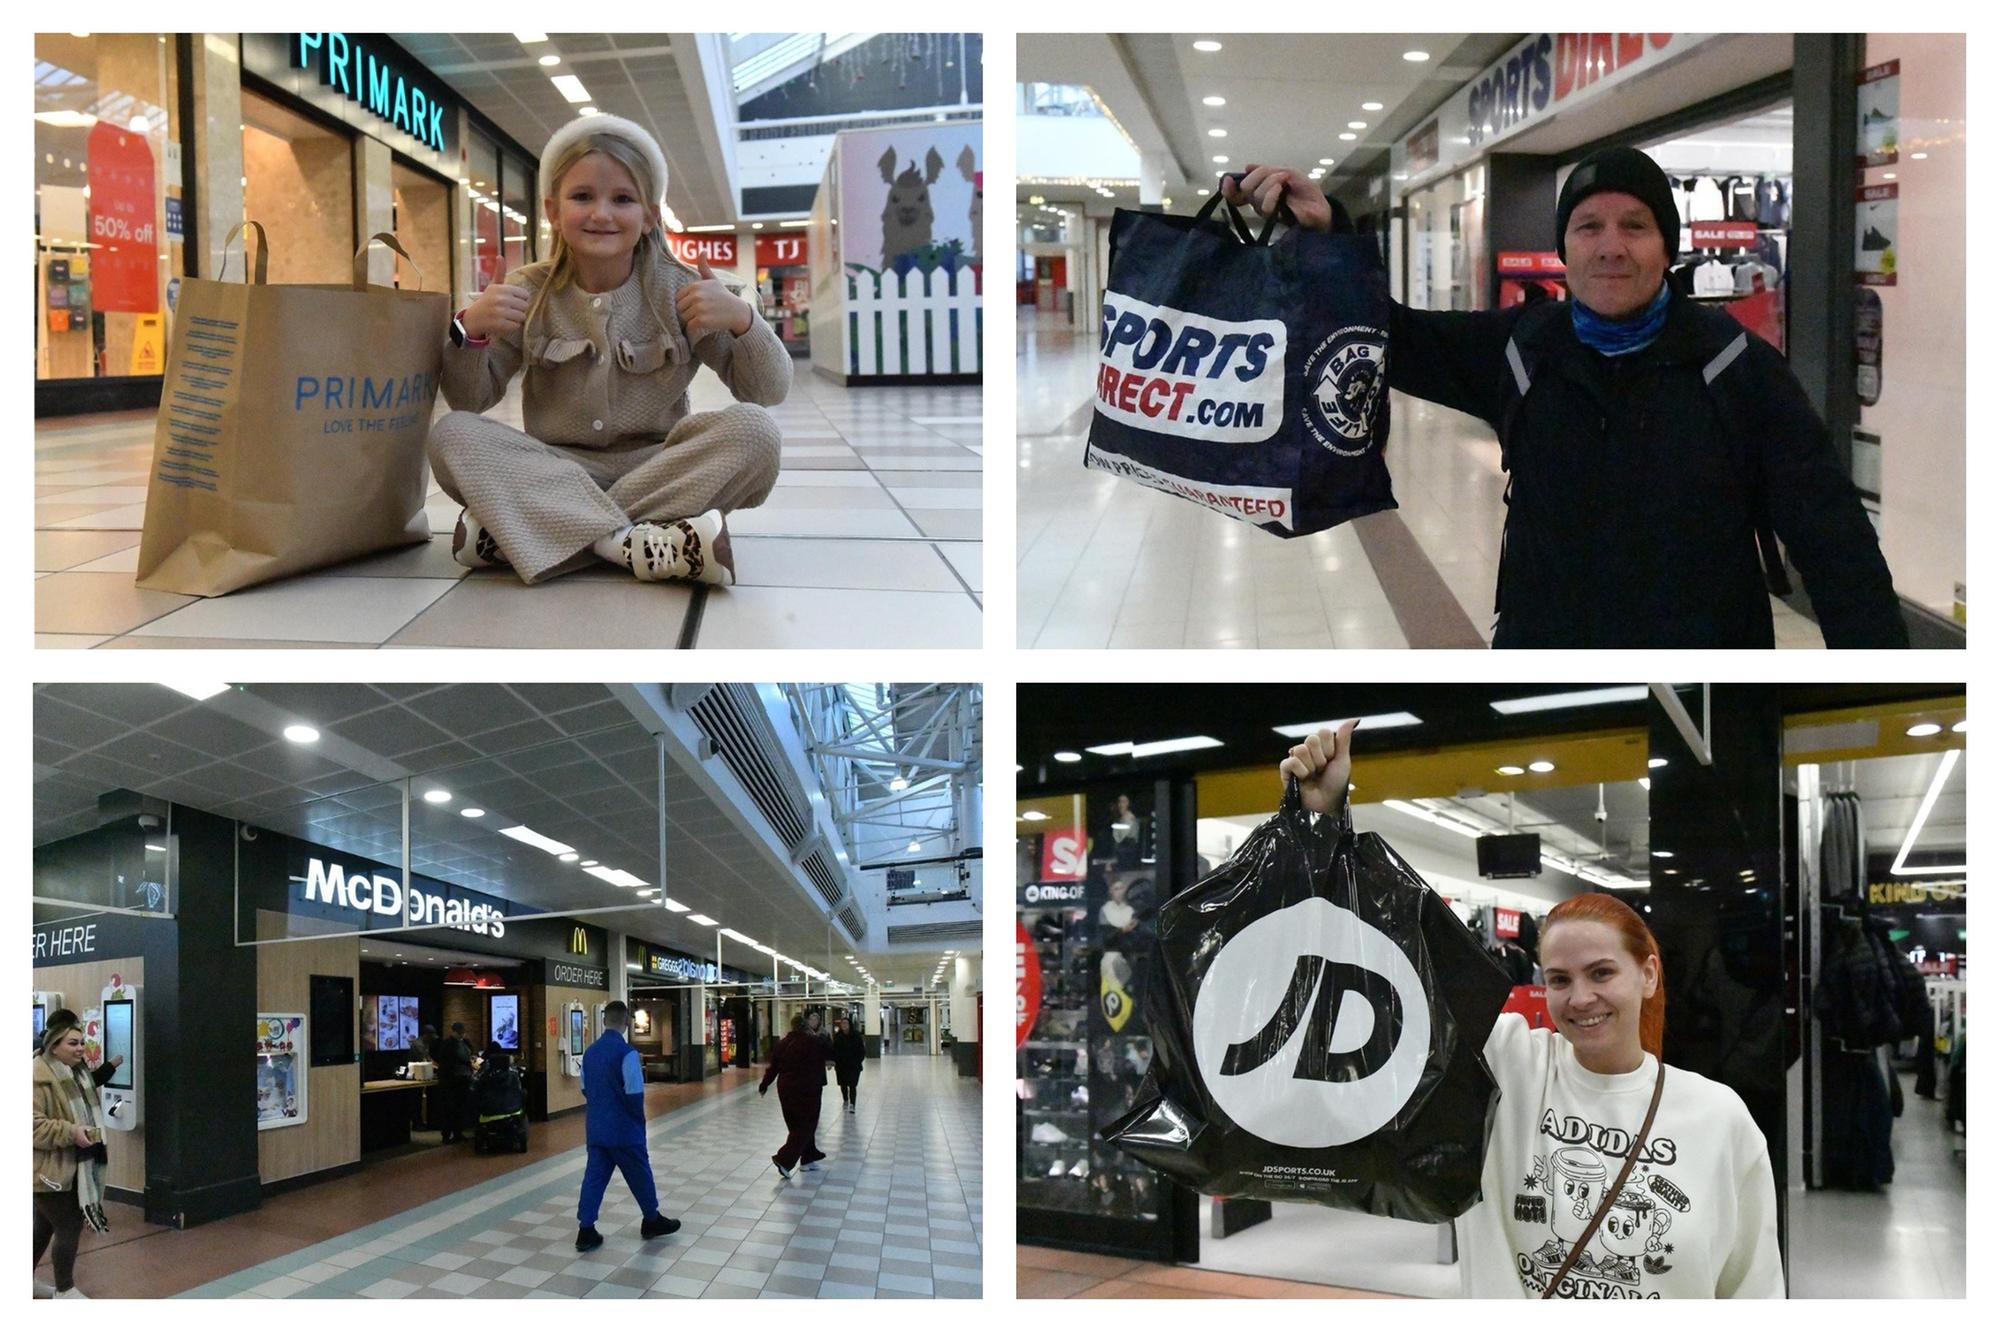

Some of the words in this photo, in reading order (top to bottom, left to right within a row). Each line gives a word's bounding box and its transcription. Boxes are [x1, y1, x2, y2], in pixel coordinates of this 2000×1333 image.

[301, 33, 445, 152] PRIMARK
[1468, 33, 1552, 147] SPORTS
[95, 216, 131, 241] 50%
[134, 223, 153, 243] off
[1695, 229, 1725, 239] SALE
[773, 239, 800, 260] TJ
[1101, 305, 1275, 383] SPORTS
[1313, 340, 1328, 356] THE
[1329, 345, 1370, 377] BAG
[295, 371, 433, 412] PRIMARK
[323, 418, 353, 434] LOVE
[358, 418, 385, 432] THE
[305, 857, 506, 939] McDonald's
[1040, 885, 1070, 900] KING
[1497, 912, 1520, 933] SALE
[50, 924, 97, 957] HERE
[554, 964, 583, 983] ORDER
[583, 969, 604, 987] HERE
[657, 956, 679, 973] GREGGS
[1219, 954, 1404, 1083] JD
[1540, 1108, 1677, 1166] ADIDAS
[1262, 1166, 1336, 1177] JDSPORTS.CO.UK
